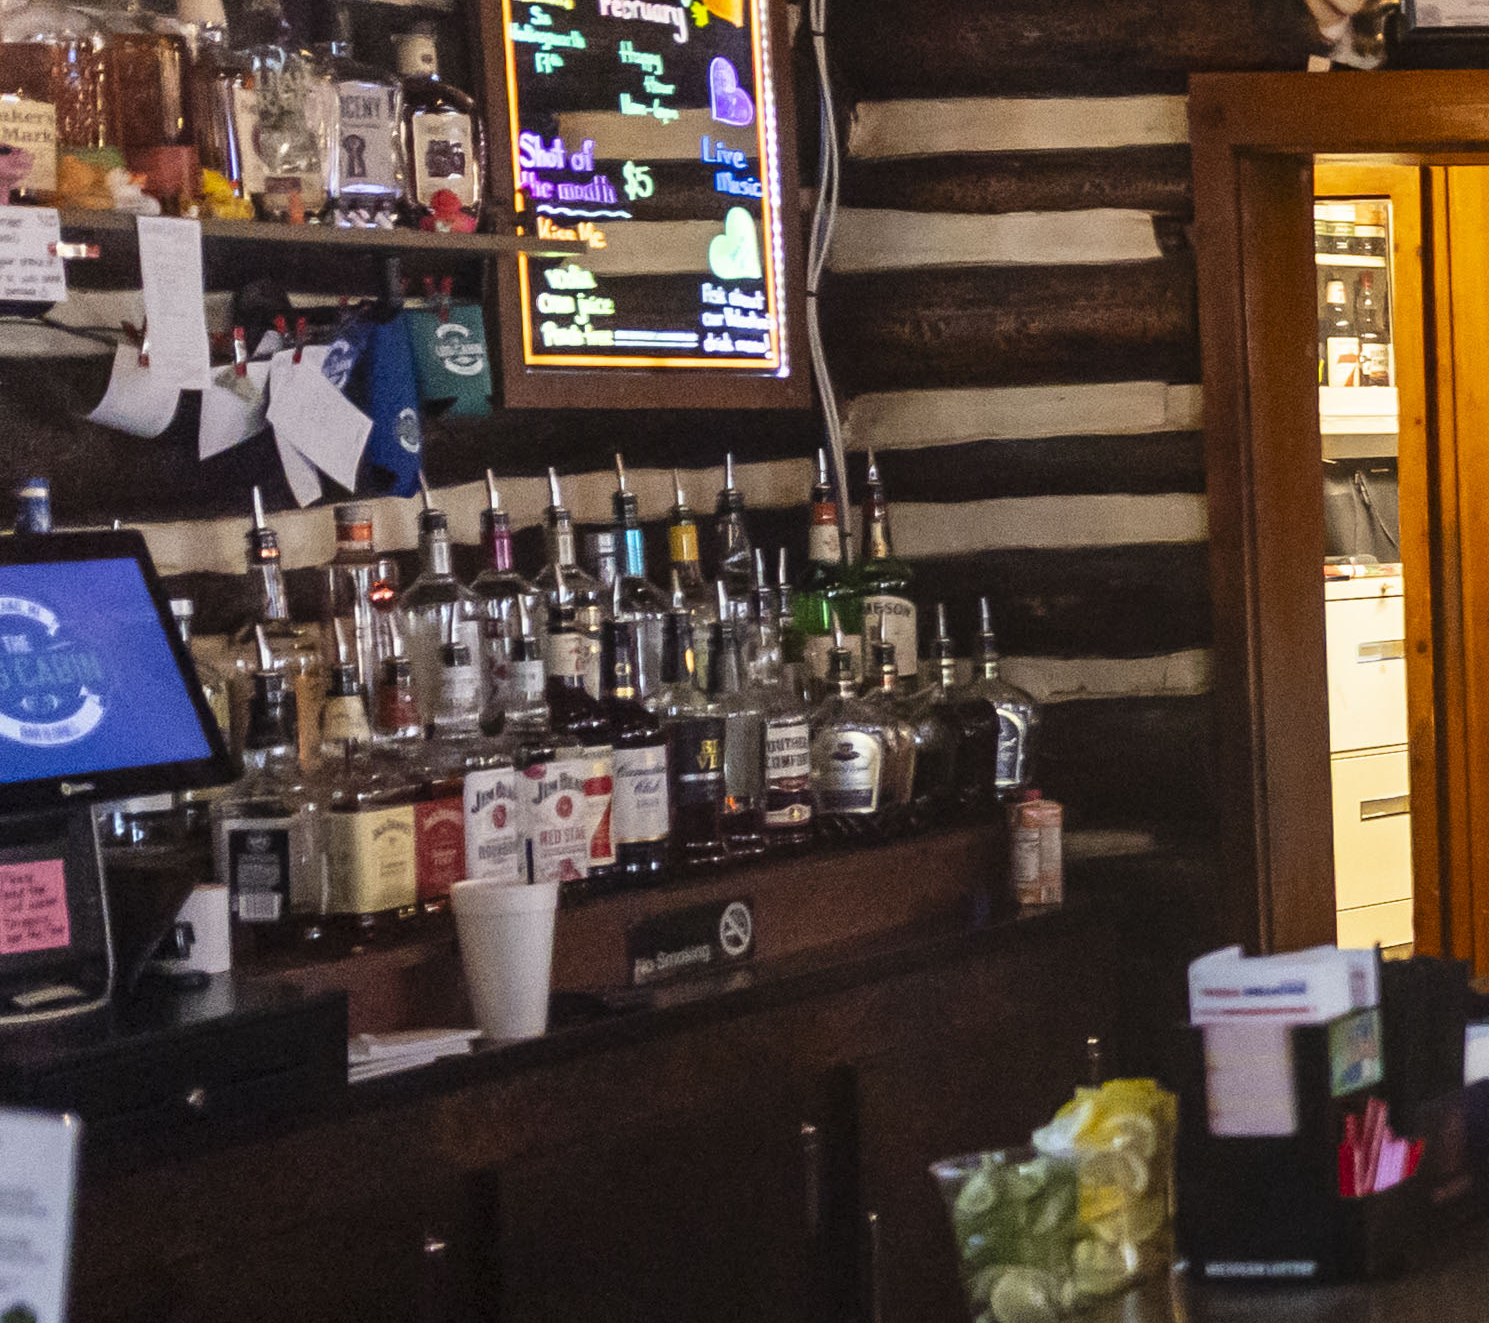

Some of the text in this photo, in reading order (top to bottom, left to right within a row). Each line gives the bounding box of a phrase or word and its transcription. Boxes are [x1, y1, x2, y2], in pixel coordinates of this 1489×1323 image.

[519, 130, 595, 172] Shot of
[702, 136, 748, 168] Live
[623, 160, 654, 200] $5
[715, 172, 763, 198] Music
[471, 788, 494, 814] JIM
[532, 779, 558, 805] JIM
[657, 947, 711, 970] Smoking
